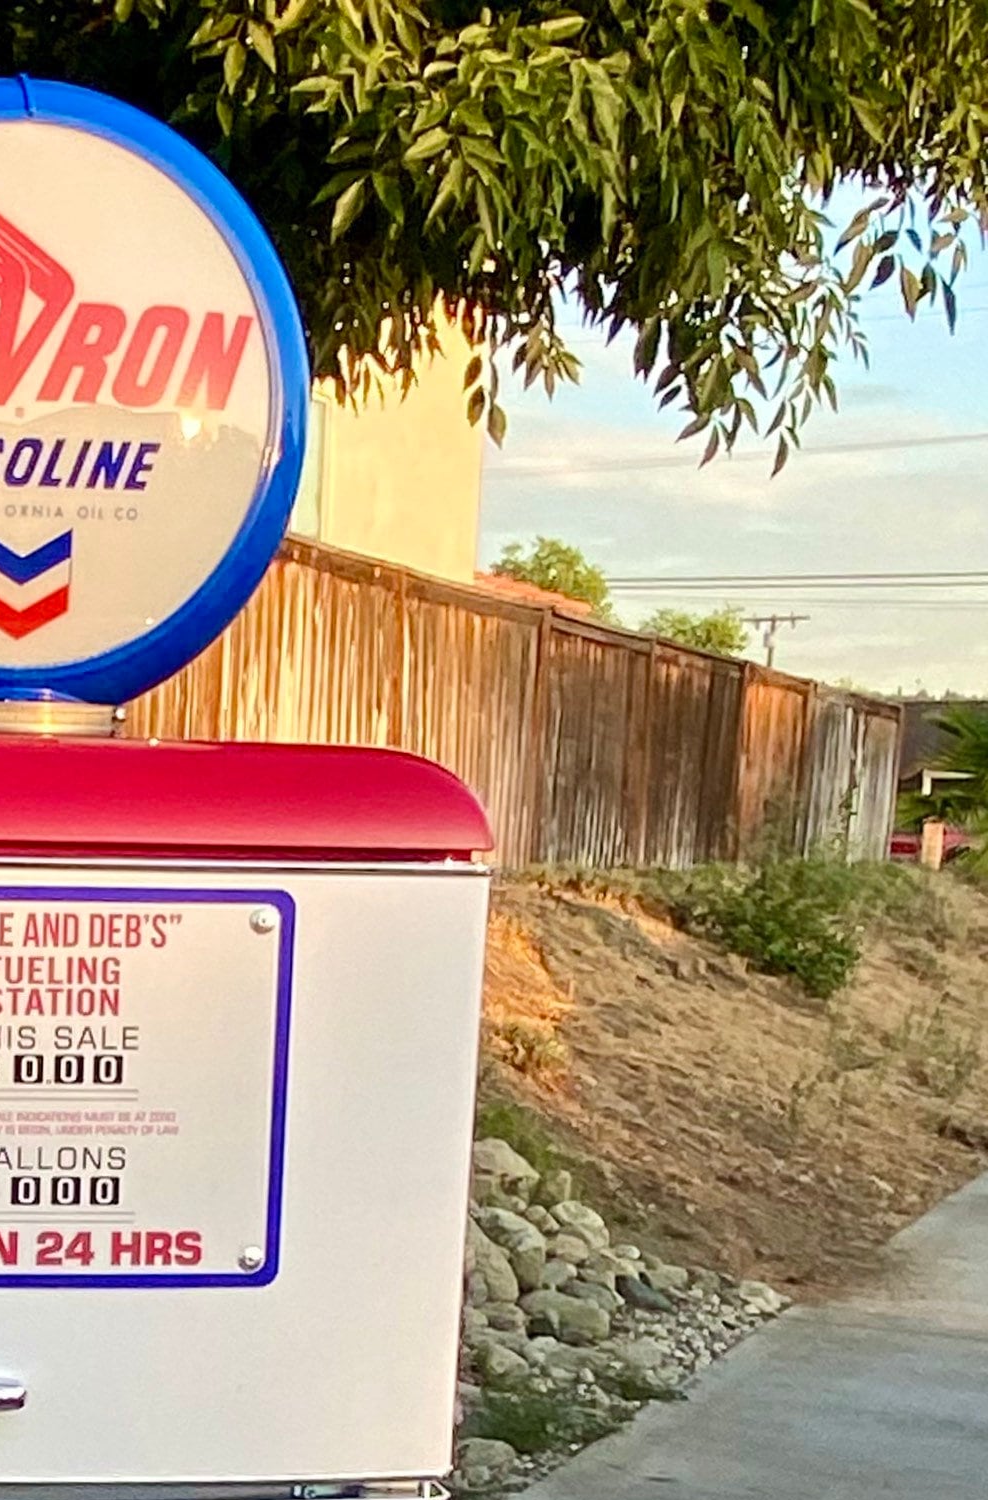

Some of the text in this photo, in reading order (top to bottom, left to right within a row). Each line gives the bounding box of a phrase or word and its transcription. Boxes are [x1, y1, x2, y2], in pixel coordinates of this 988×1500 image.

[76, 506, 104, 520] OIL
[114, 507, 139, 521] CO
[22, 912, 80, 948] AND
[53, 1025, 140, 1051] SALE
[35, 1231, 95, 1266] 24
[110, 1231, 203, 1266] HRS
